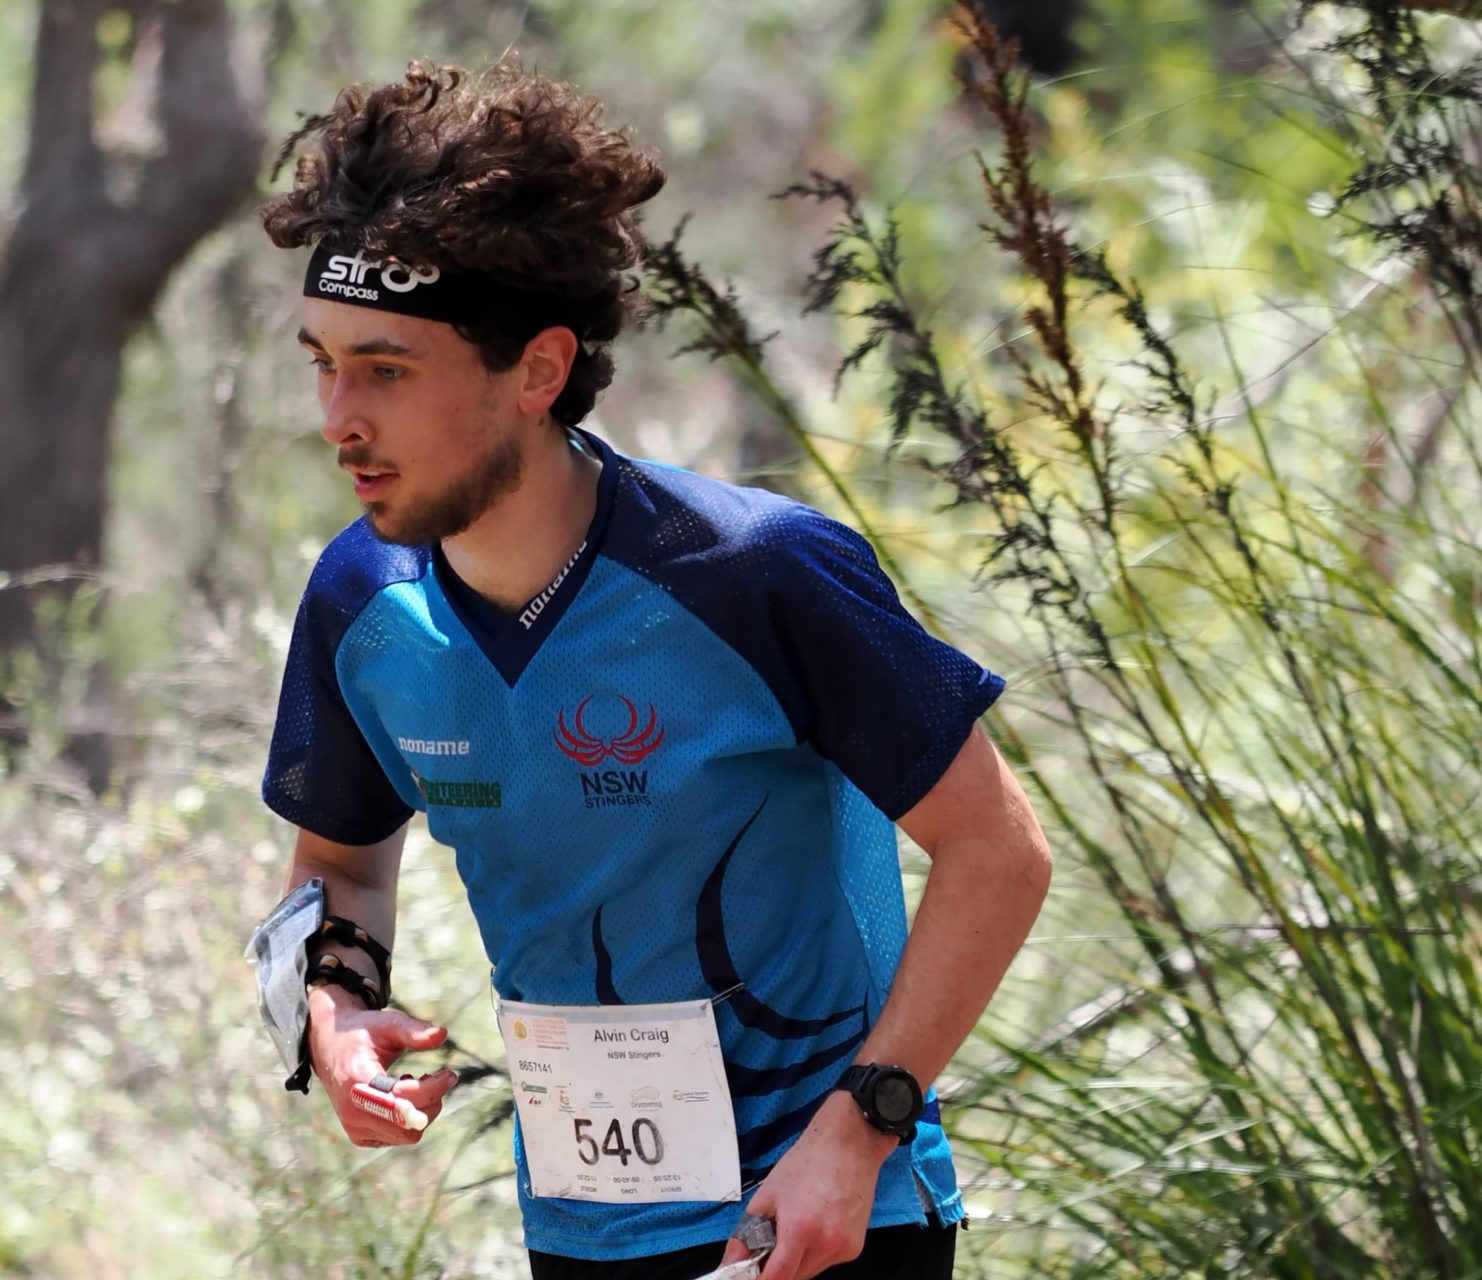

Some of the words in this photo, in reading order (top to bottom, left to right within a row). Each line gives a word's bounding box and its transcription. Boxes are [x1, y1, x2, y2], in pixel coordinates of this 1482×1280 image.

[318, 279, 379, 301] Compass
[398, 737, 470, 755] noname
[580, 770, 648, 796] NSW
[584, 794, 652, 809] STINGERS
[594, 1028, 627, 1043] Alvin
[630, 1027, 669, 1044] Craig
[607, 1051, 626, 1059] NSW
[574, 1117, 664, 1166] 540
